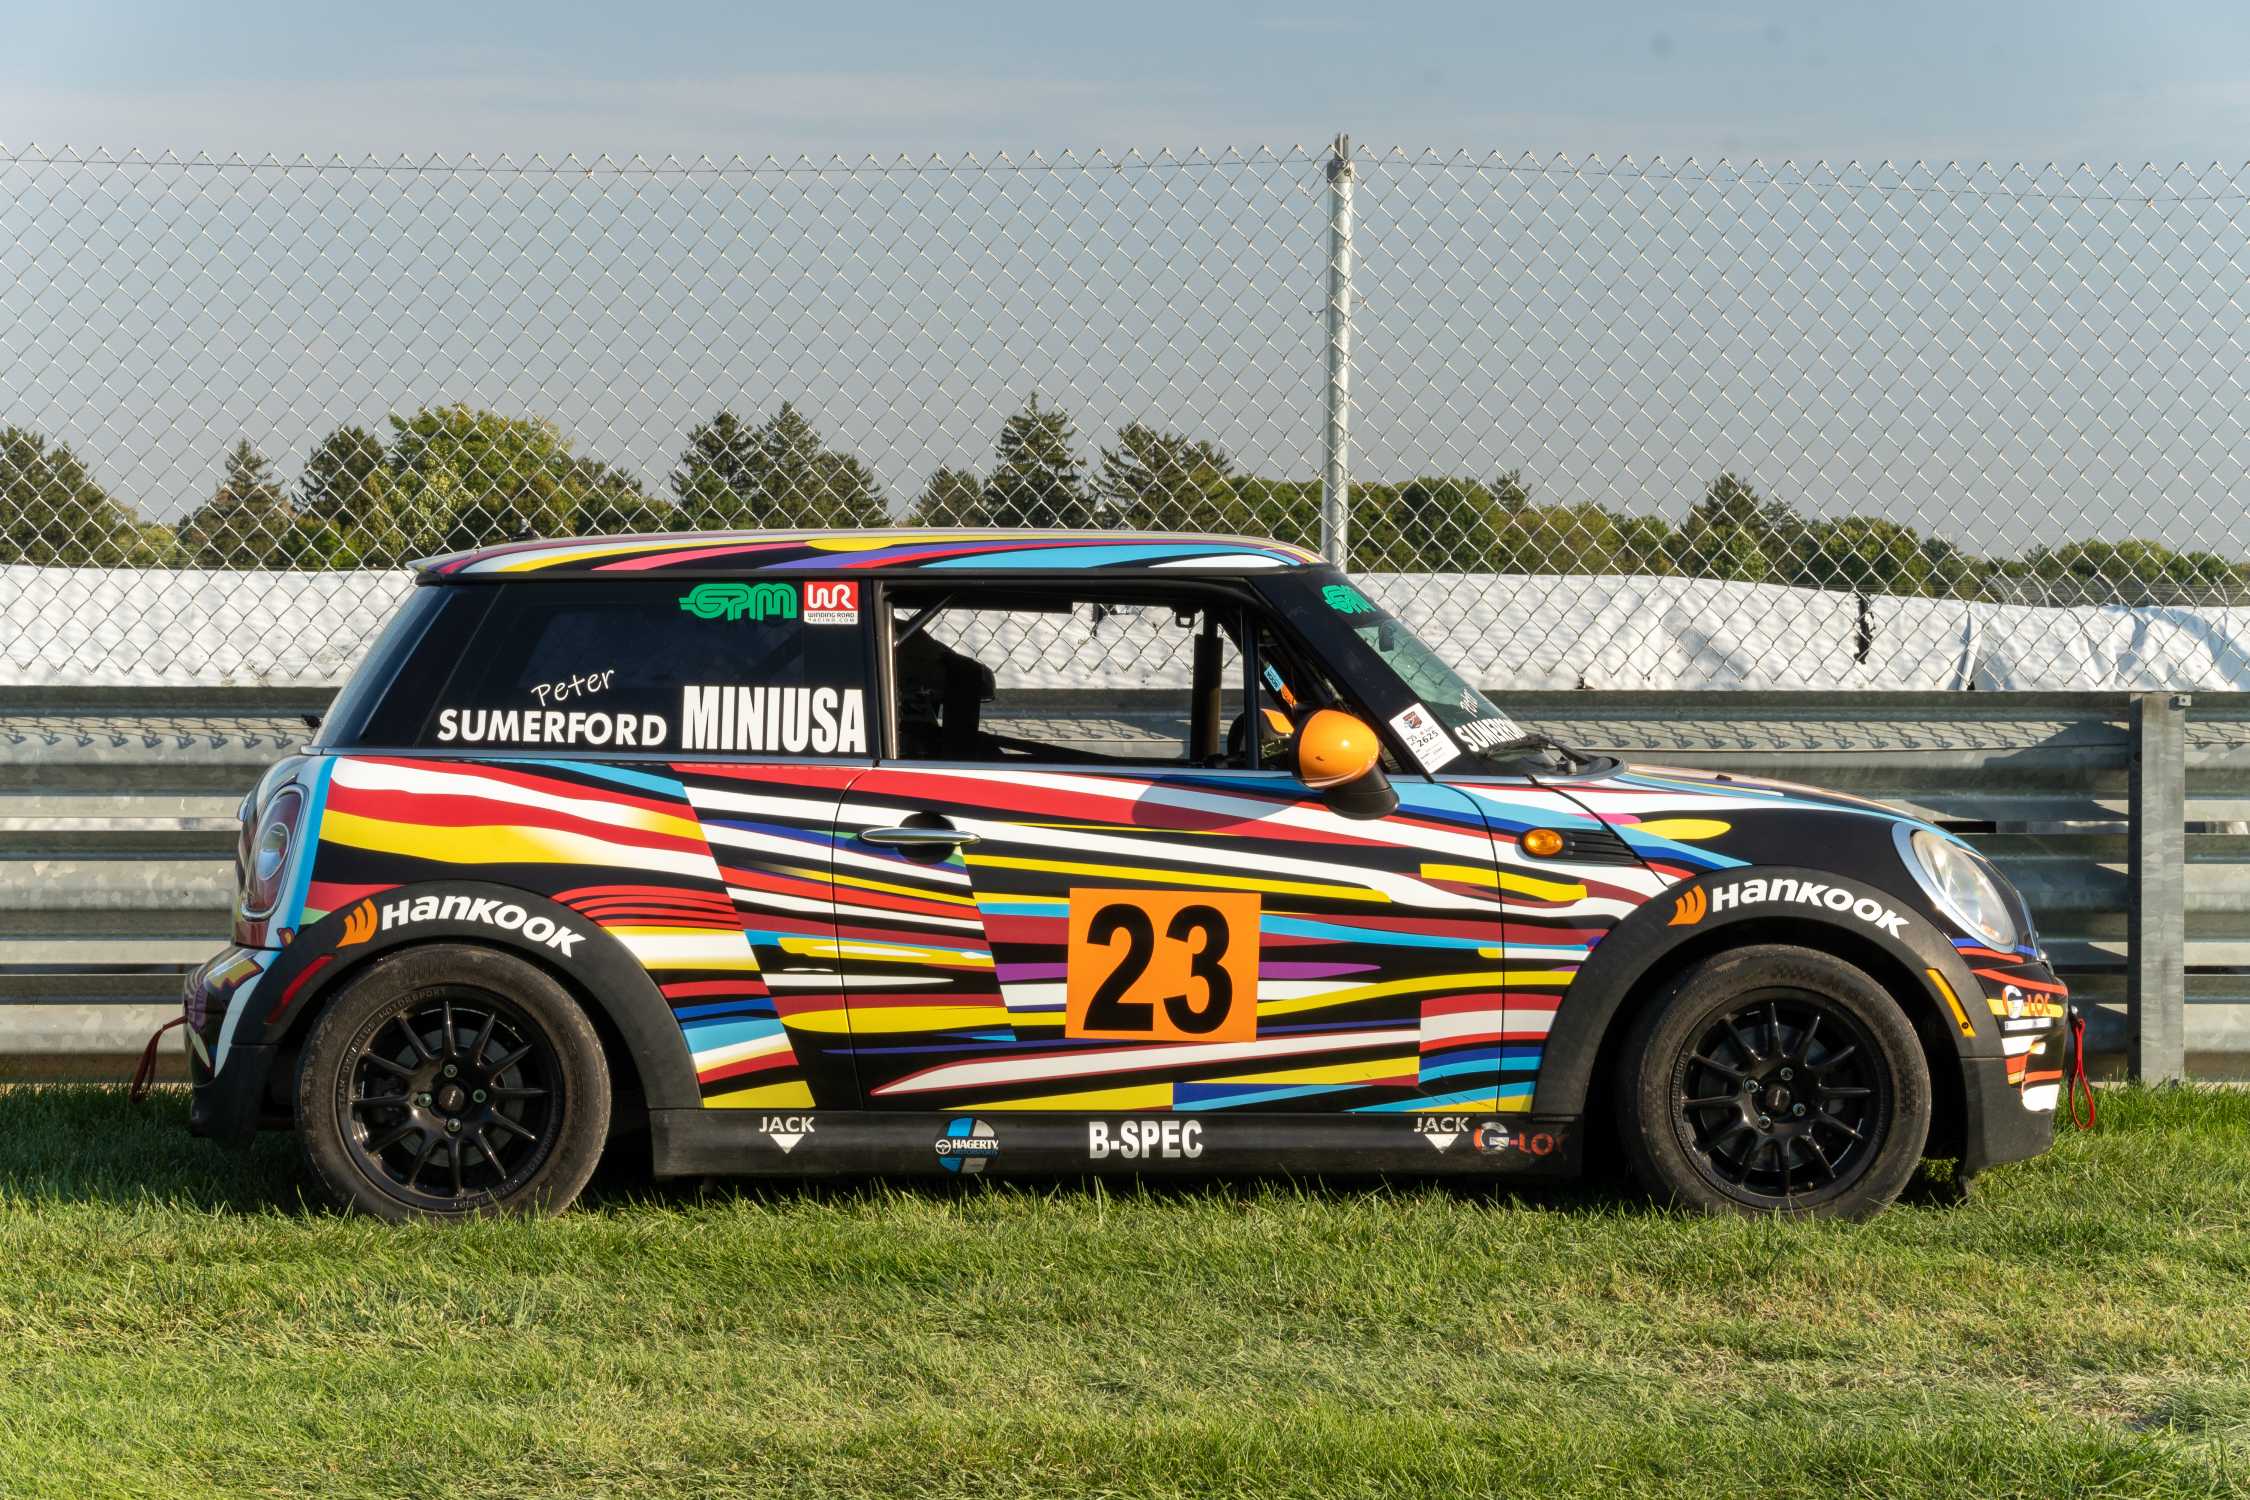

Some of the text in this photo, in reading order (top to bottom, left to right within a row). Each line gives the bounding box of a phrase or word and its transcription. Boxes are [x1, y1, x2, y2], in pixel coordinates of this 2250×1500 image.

[531, 668, 616, 707] Peter
[437, 708, 667, 747] SUMERFORD
[682, 685, 867, 753] MINIUSA
[1083, 903, 1233, 1034] 23
[758, 1116, 816, 1133] JACK
[1088, 1120, 1204, 1159] B-SPEC
[1413, 1116, 1471, 1133] JACK
[952, 1139, 998, 1150] HAGERTY
